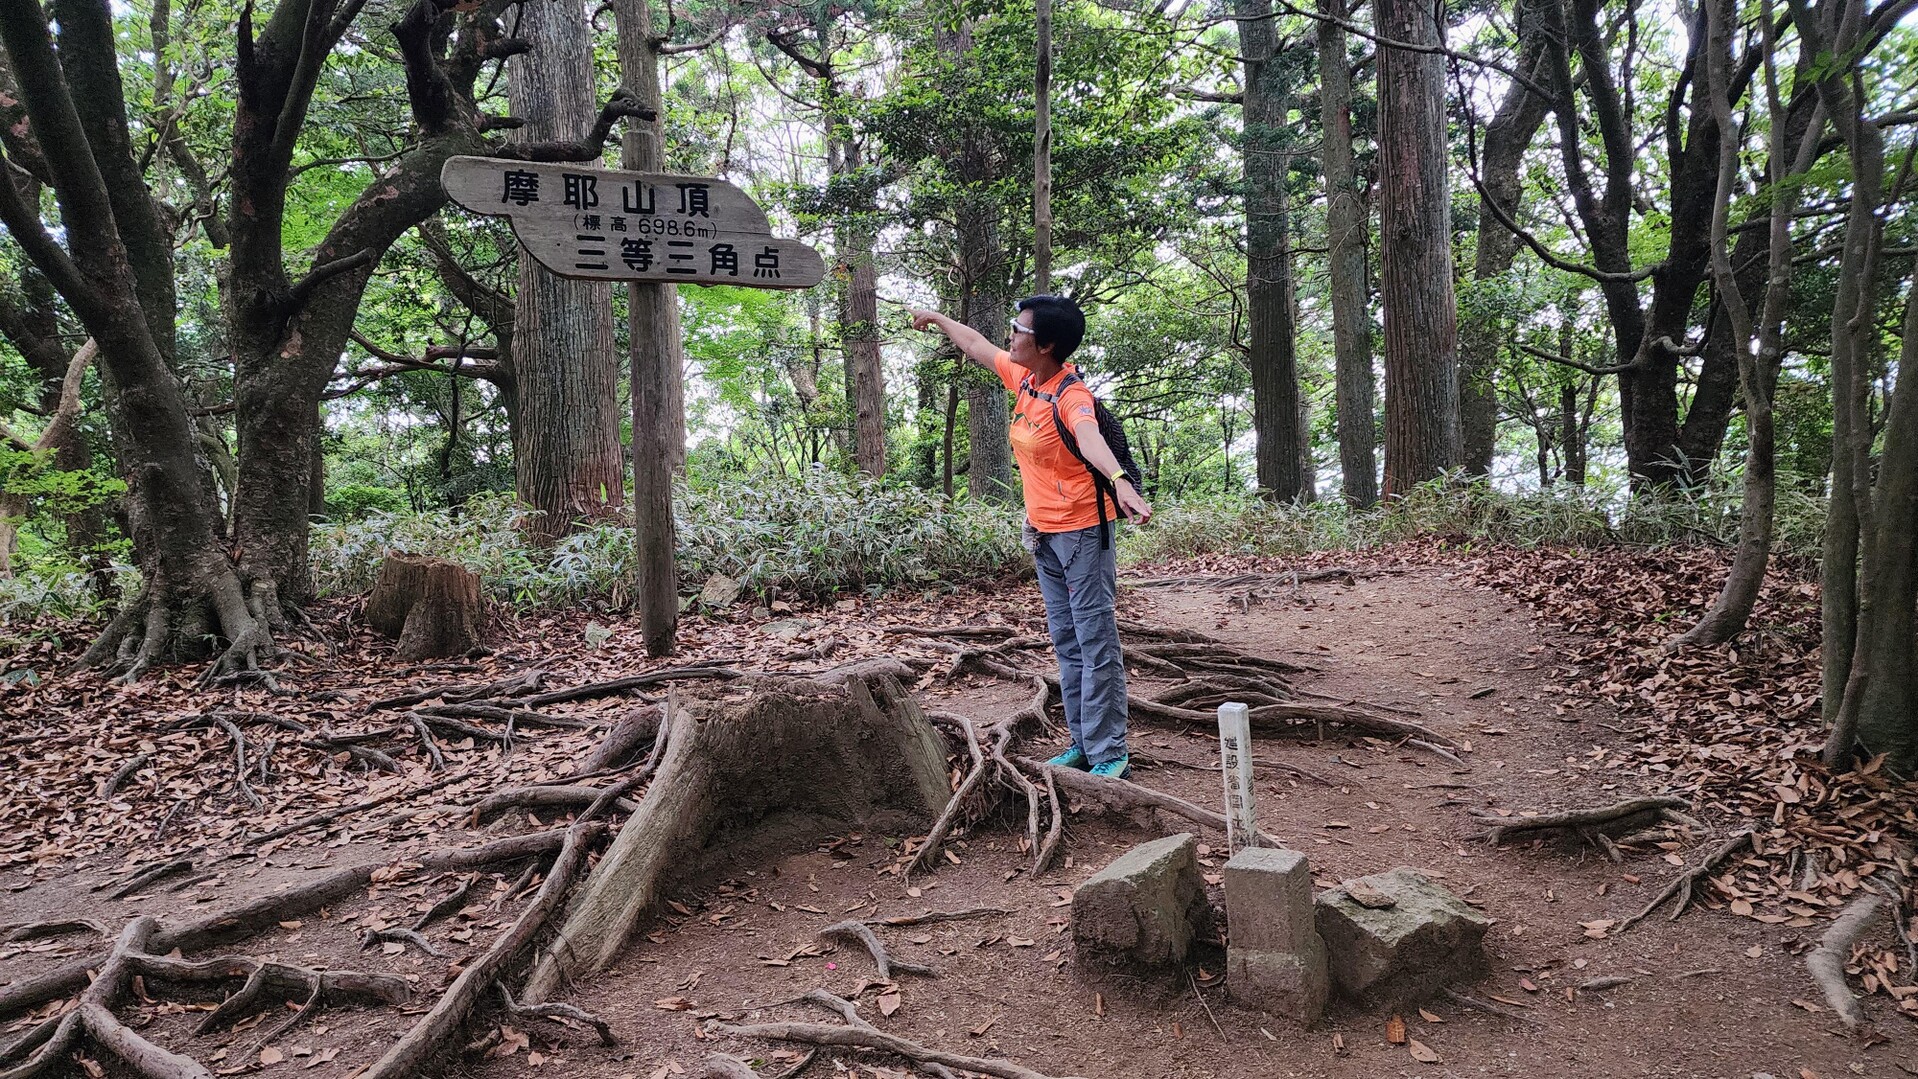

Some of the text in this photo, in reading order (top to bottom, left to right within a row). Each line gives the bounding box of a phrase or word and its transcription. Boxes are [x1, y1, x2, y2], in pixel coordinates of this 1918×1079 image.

[501, 170, 710, 218] 摩耶山頂
[575, 235, 781, 278] 三等三角点
